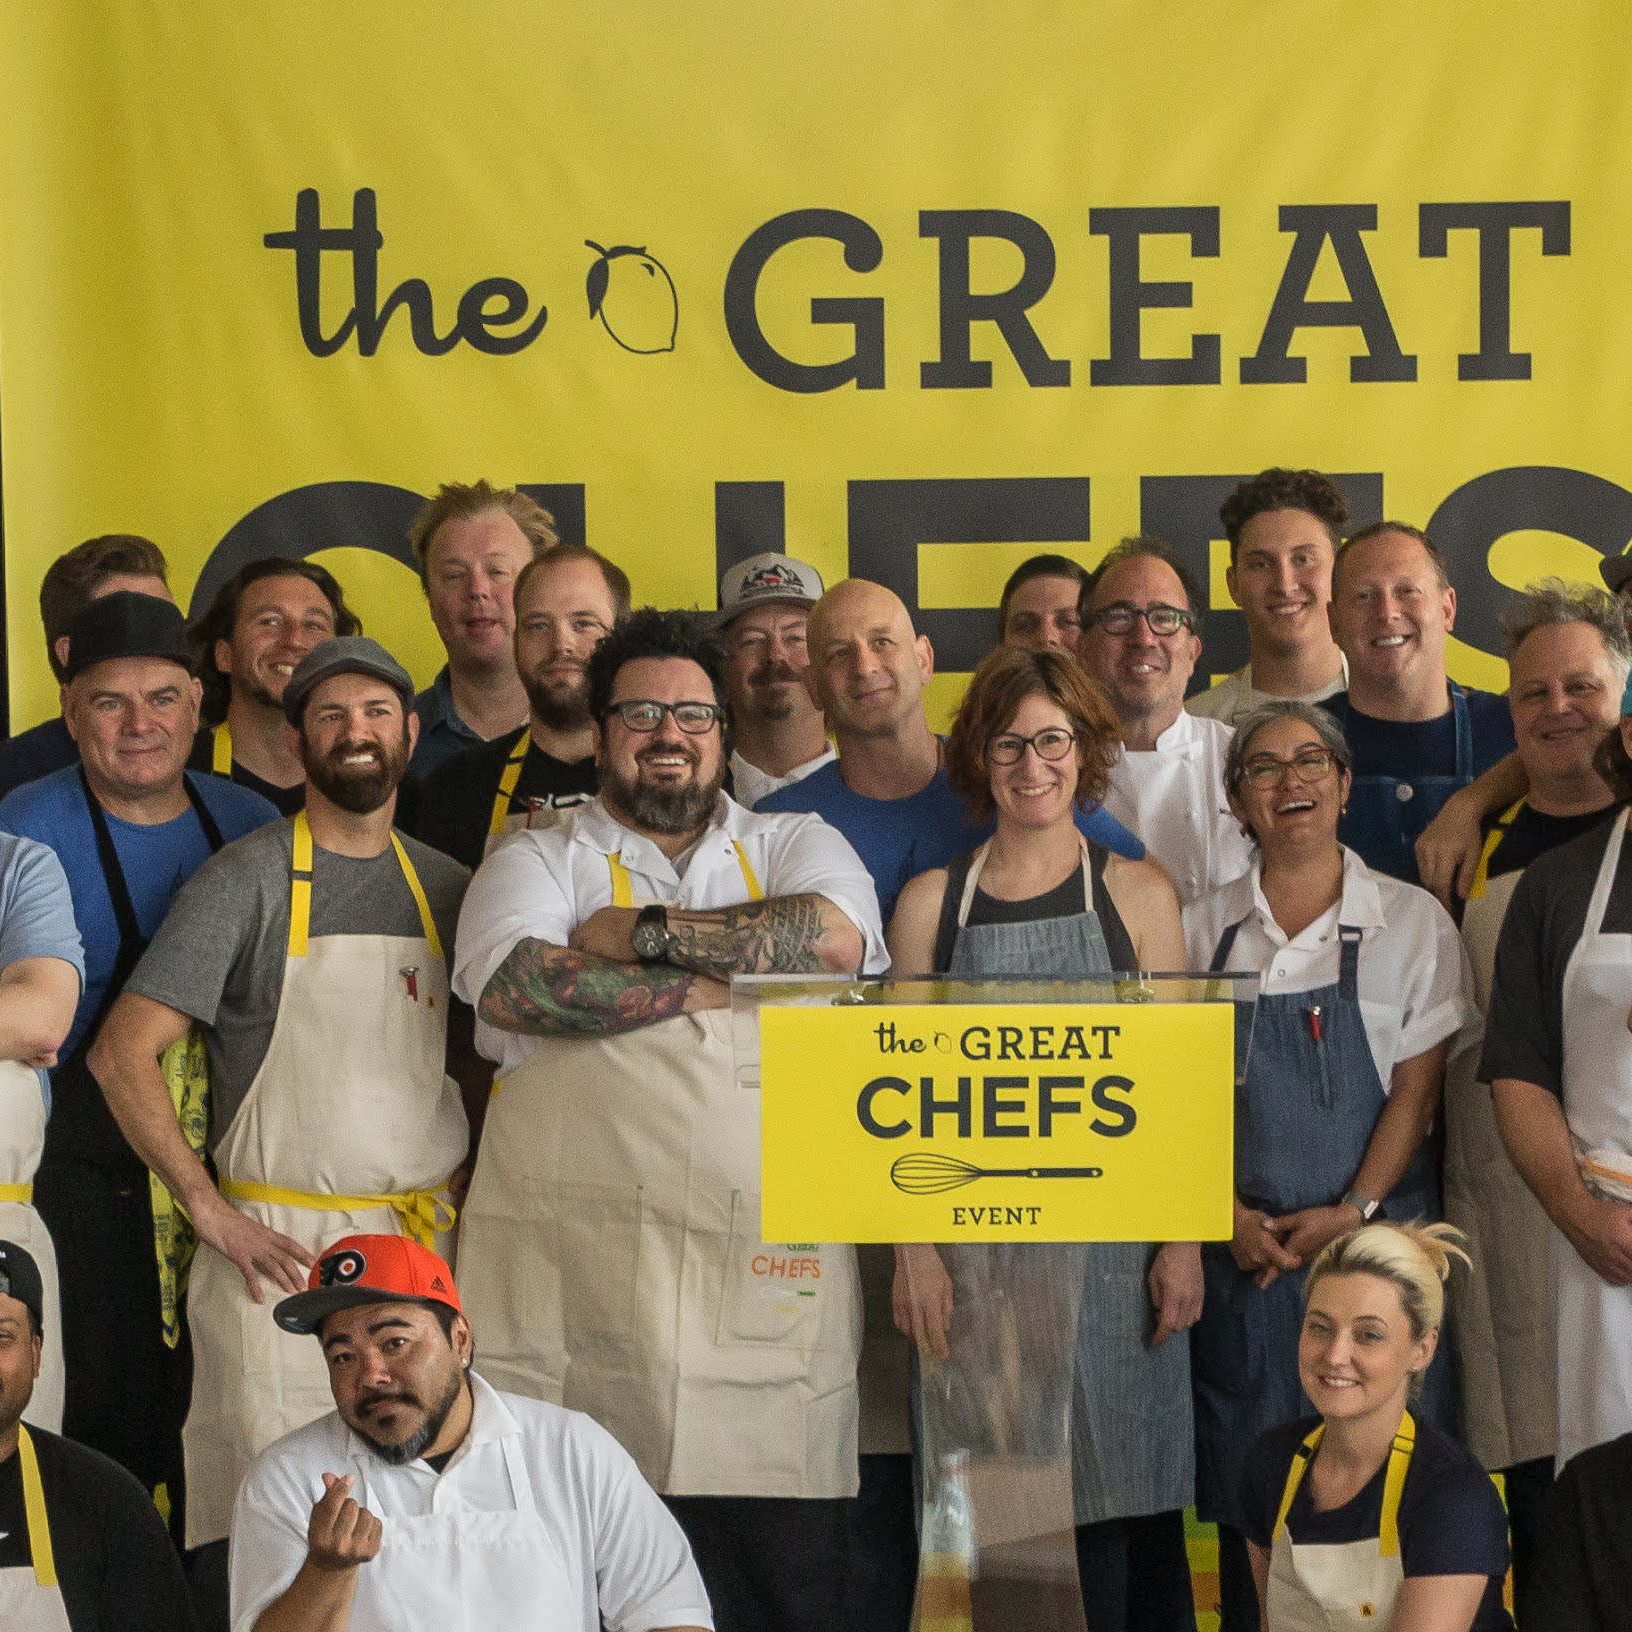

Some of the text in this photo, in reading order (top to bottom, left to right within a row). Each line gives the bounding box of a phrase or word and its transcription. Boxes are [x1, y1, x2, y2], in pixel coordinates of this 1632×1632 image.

[263, 187, 1573, 394] the GREAT
[873, 1022, 1121, 1060] the GREAT
[856, 1075, 1138, 1139] CHEFS
[952, 1207, 1043, 1226] EVENT
[751, 1255, 821, 1279] CHEFS
